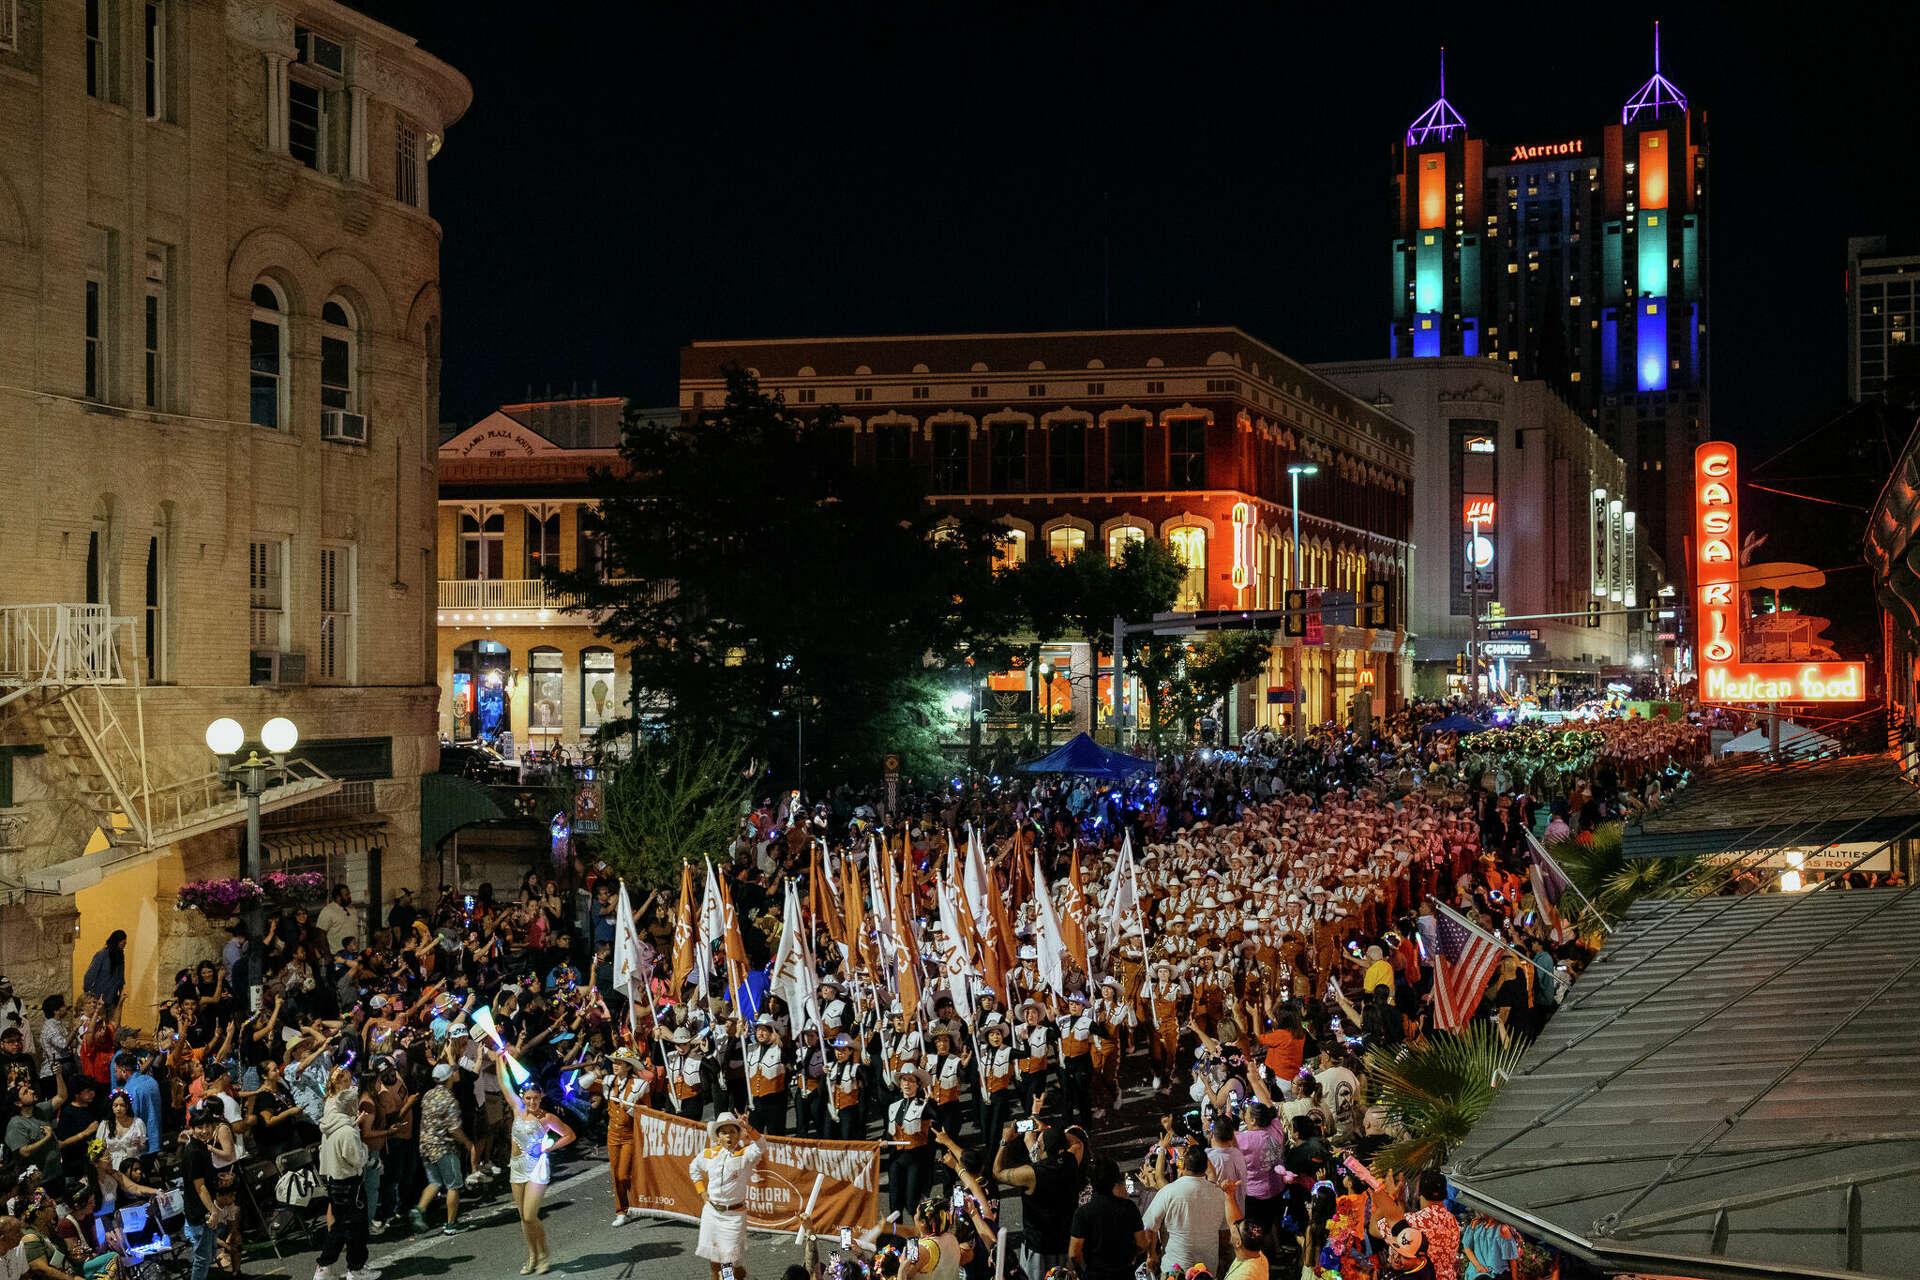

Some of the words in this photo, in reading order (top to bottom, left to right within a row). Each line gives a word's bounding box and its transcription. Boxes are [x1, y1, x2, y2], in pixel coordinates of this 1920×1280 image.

[1511, 139, 1583, 161] Marriott
[487, 431, 512, 439] PLAZA
[515, 435, 535, 456] SOUTH
[1702, 454, 1732, 563] CASA
[1612, 555, 1621, 592] IMAX
[1703, 581, 1734, 662] RIO
[1484, 643, 1531, 656] CHIPOTLE
[1706, 667, 1792, 699] Mexican
[1825, 860, 1862, 869] ROO
[640, 1113, 667, 1158] THE
[667, 1122, 708, 1157] SHOW
[768, 1142, 795, 1168] THE
[745, 1185, 790, 1203] GHORN
